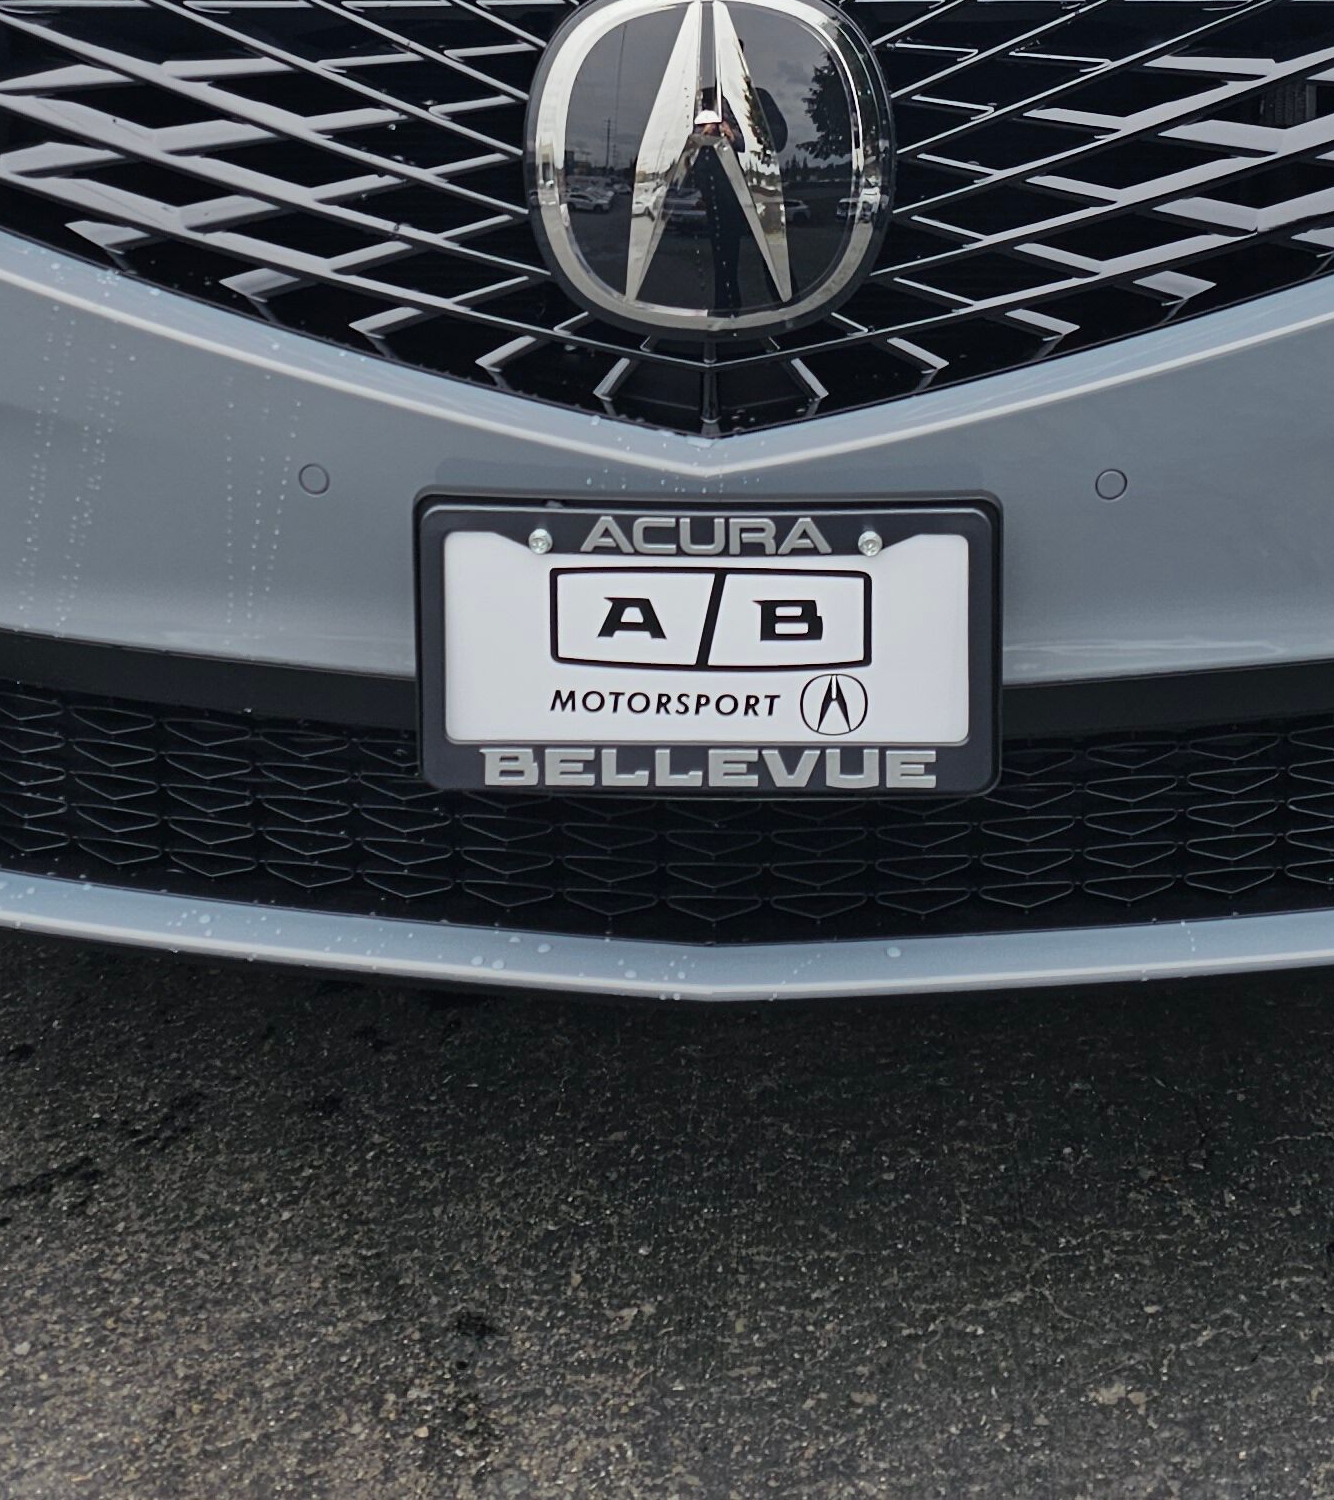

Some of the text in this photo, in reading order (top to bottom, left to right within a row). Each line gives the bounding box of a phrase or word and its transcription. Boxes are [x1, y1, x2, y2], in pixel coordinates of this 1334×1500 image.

[579, 515, 833, 556] ACURA
[597, 596, 824, 642] A B
[550, 689, 782, 717] MOTORSPORT
[479, 747, 938, 789] BELLEVUE
